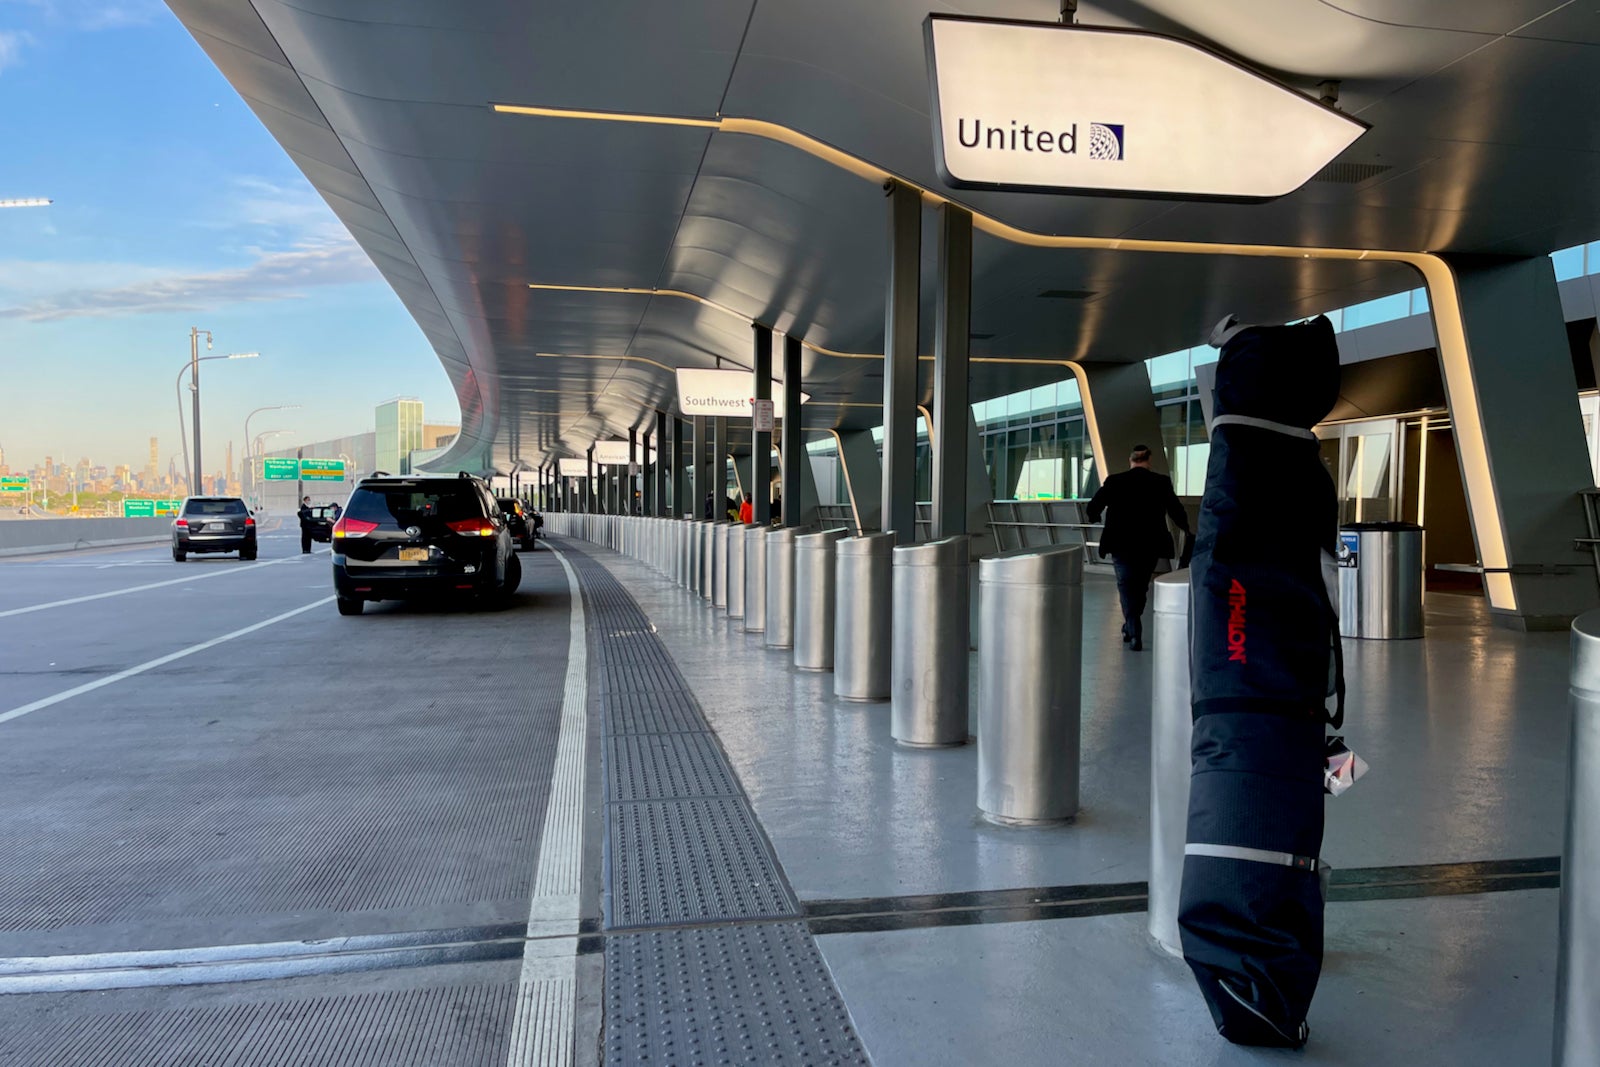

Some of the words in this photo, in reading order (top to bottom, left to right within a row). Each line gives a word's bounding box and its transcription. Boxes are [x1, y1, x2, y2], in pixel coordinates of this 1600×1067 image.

[958, 118, 1078, 154] United
[685, 396, 745, 408] Southwest
[1227, 578, 1247, 661] ATHALON
